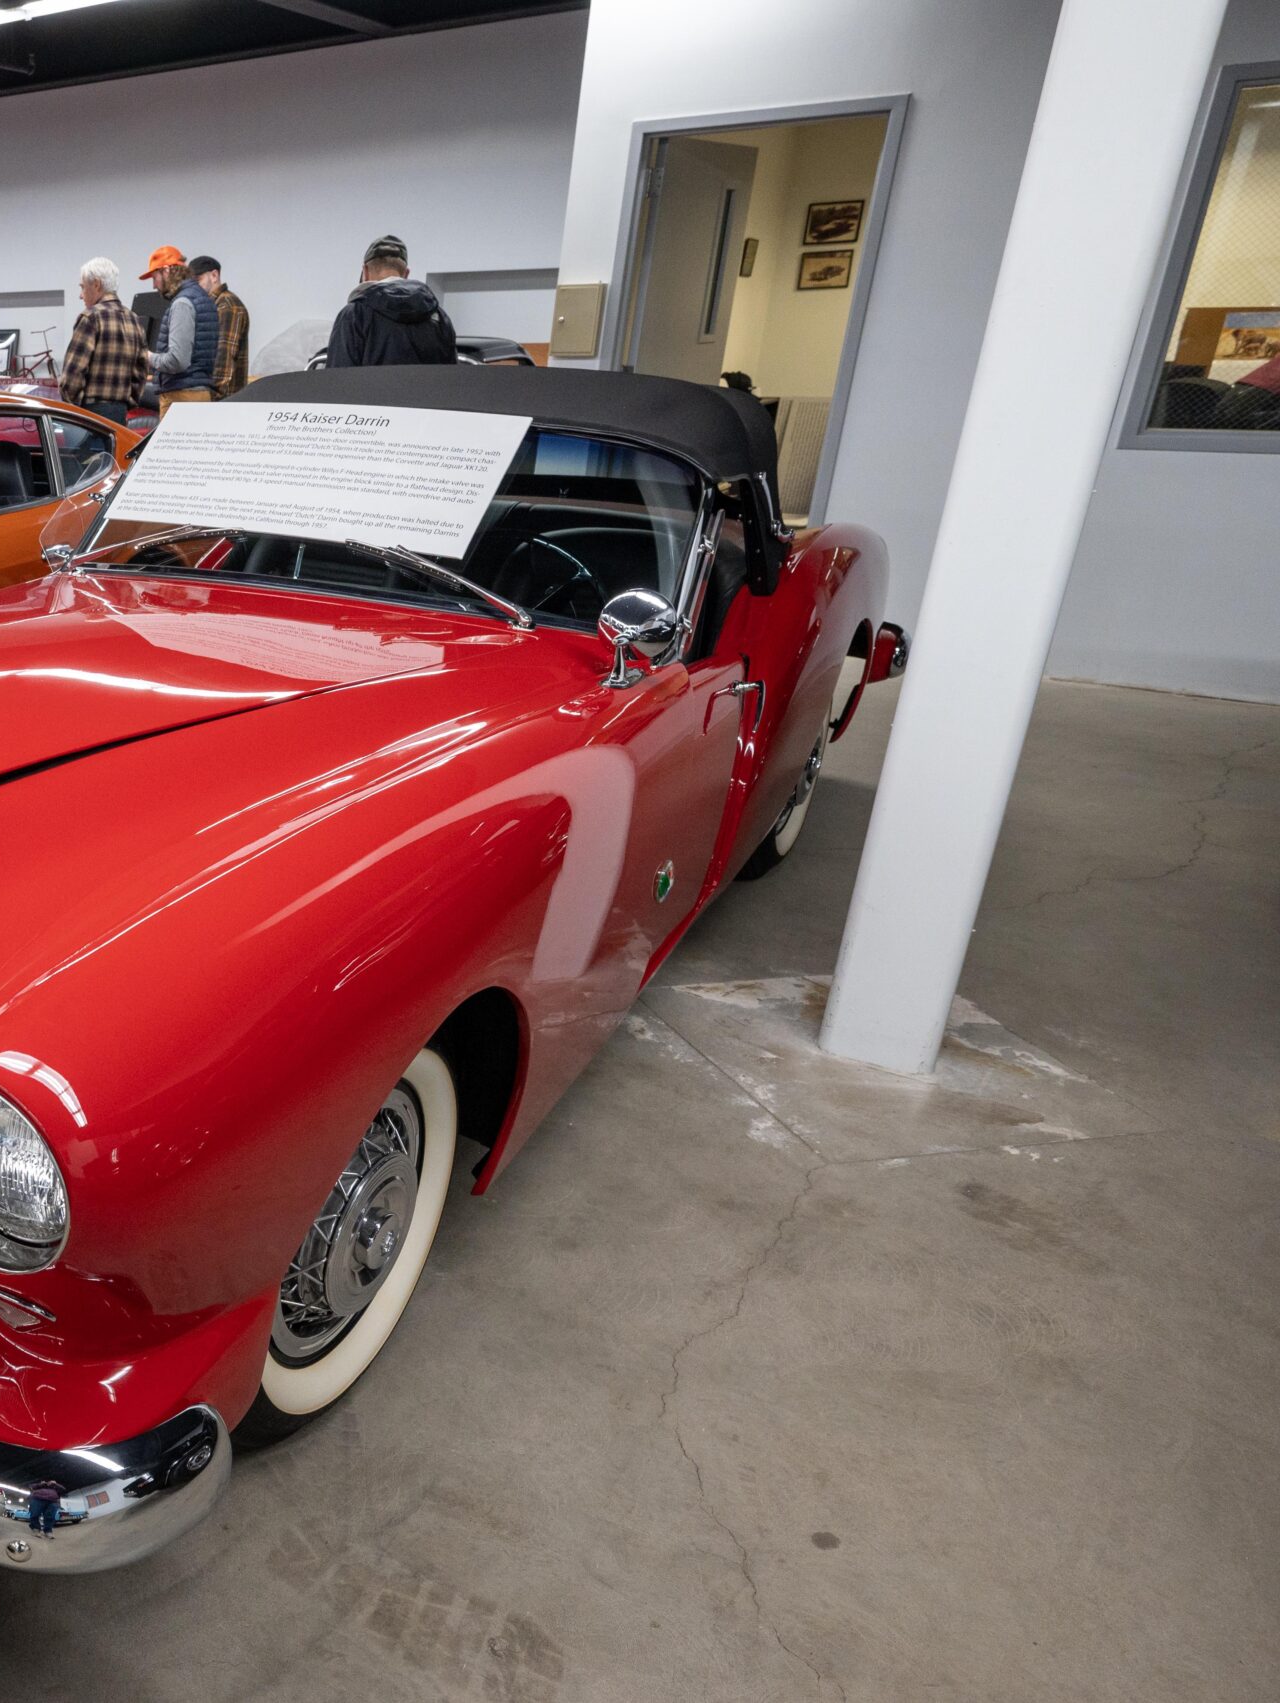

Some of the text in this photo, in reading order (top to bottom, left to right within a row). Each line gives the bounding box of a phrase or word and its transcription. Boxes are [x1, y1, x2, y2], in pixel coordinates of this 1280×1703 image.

[266, 411, 390, 427] 1954 Kaiser Darrin
[302, 424, 333, 432] Brothers
[334, 426, 377, 435] Collection)
[307, 482, 346, 490] transmission
[409, 484, 439, 492] flathead
[284, 519, 311, 527] through
[361, 512, 400, 521] production
[415, 518, 439, 526] halted
[340, 517, 365, 525] bought
[397, 525, 433, 535] remaining
[433, 529, 460, 537] Darrins
